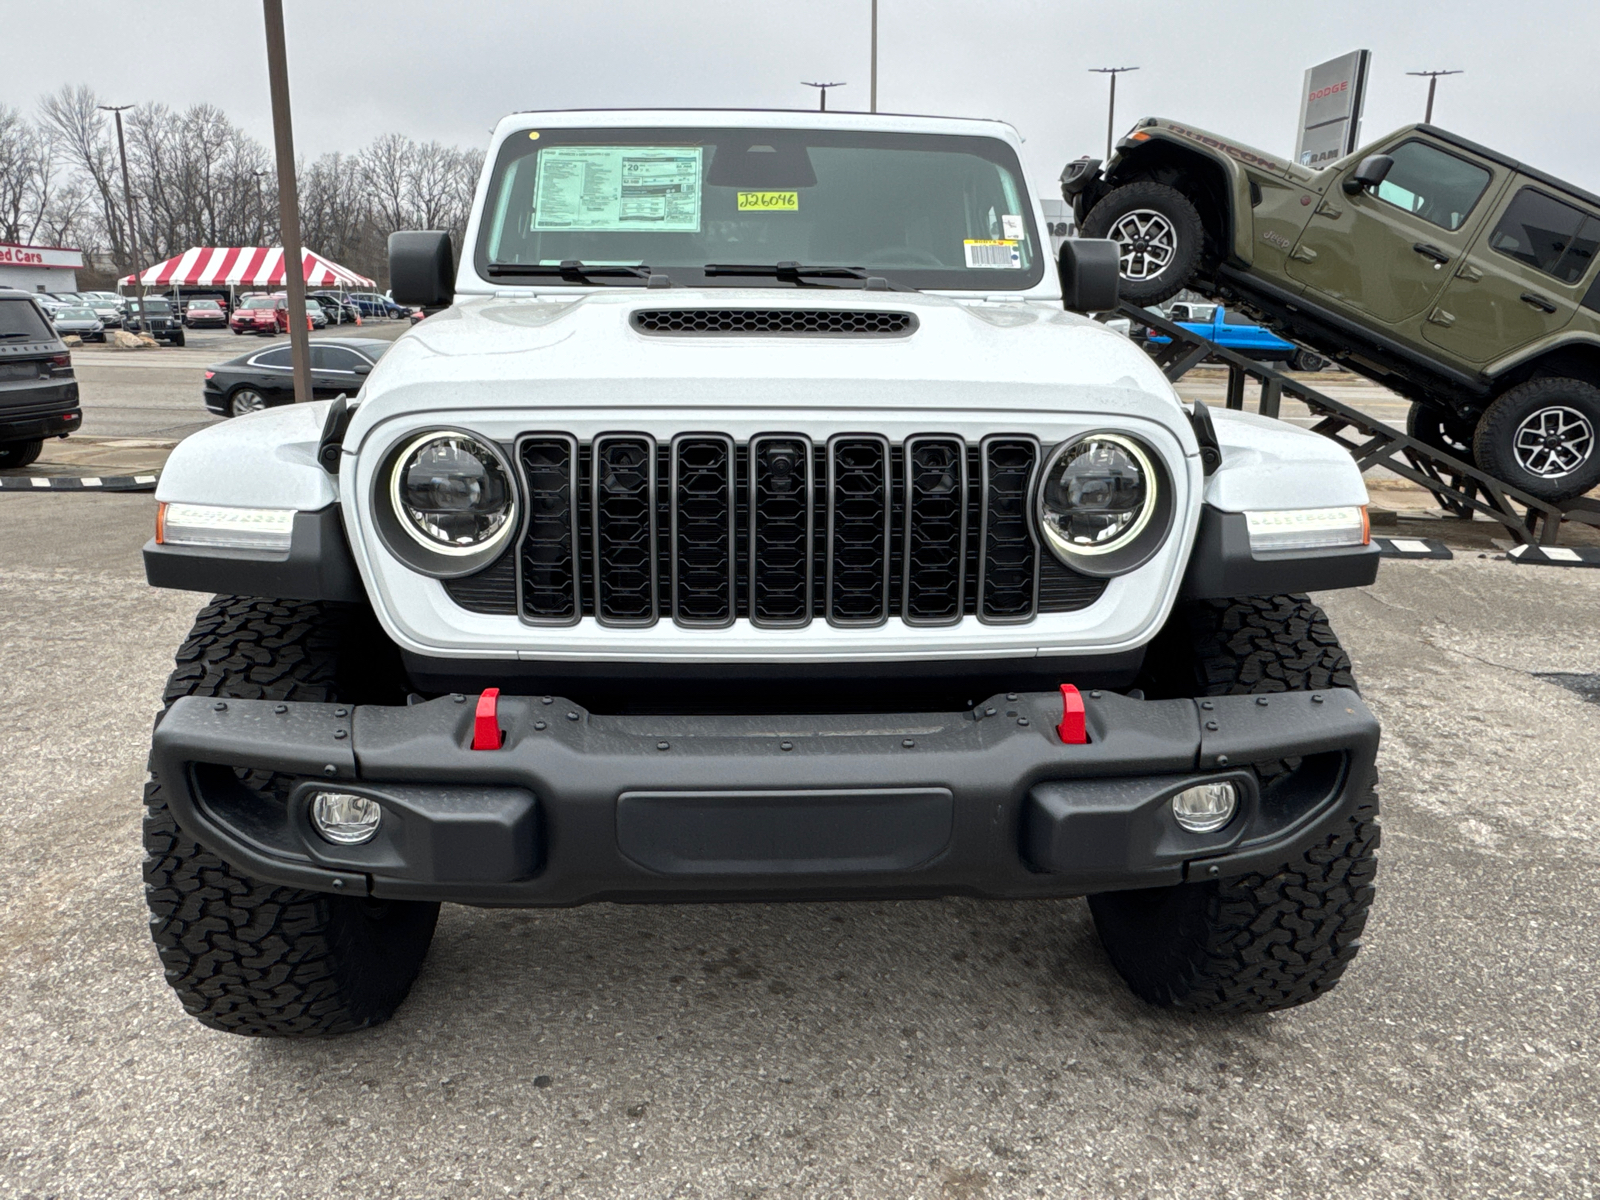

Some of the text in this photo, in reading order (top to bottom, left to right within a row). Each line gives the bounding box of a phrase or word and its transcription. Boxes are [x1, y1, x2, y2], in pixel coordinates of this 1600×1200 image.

[1309, 81, 1348, 102] DODGE
[1168, 124, 1276, 170] RUBICON
[1310, 148, 1339, 163] RAM
[627, 163, 639, 172] 20
[739, 193, 795, 208] J26046
[1263, 230, 1290, 249] Jeep
[15, 249, 43, 263] Cars
